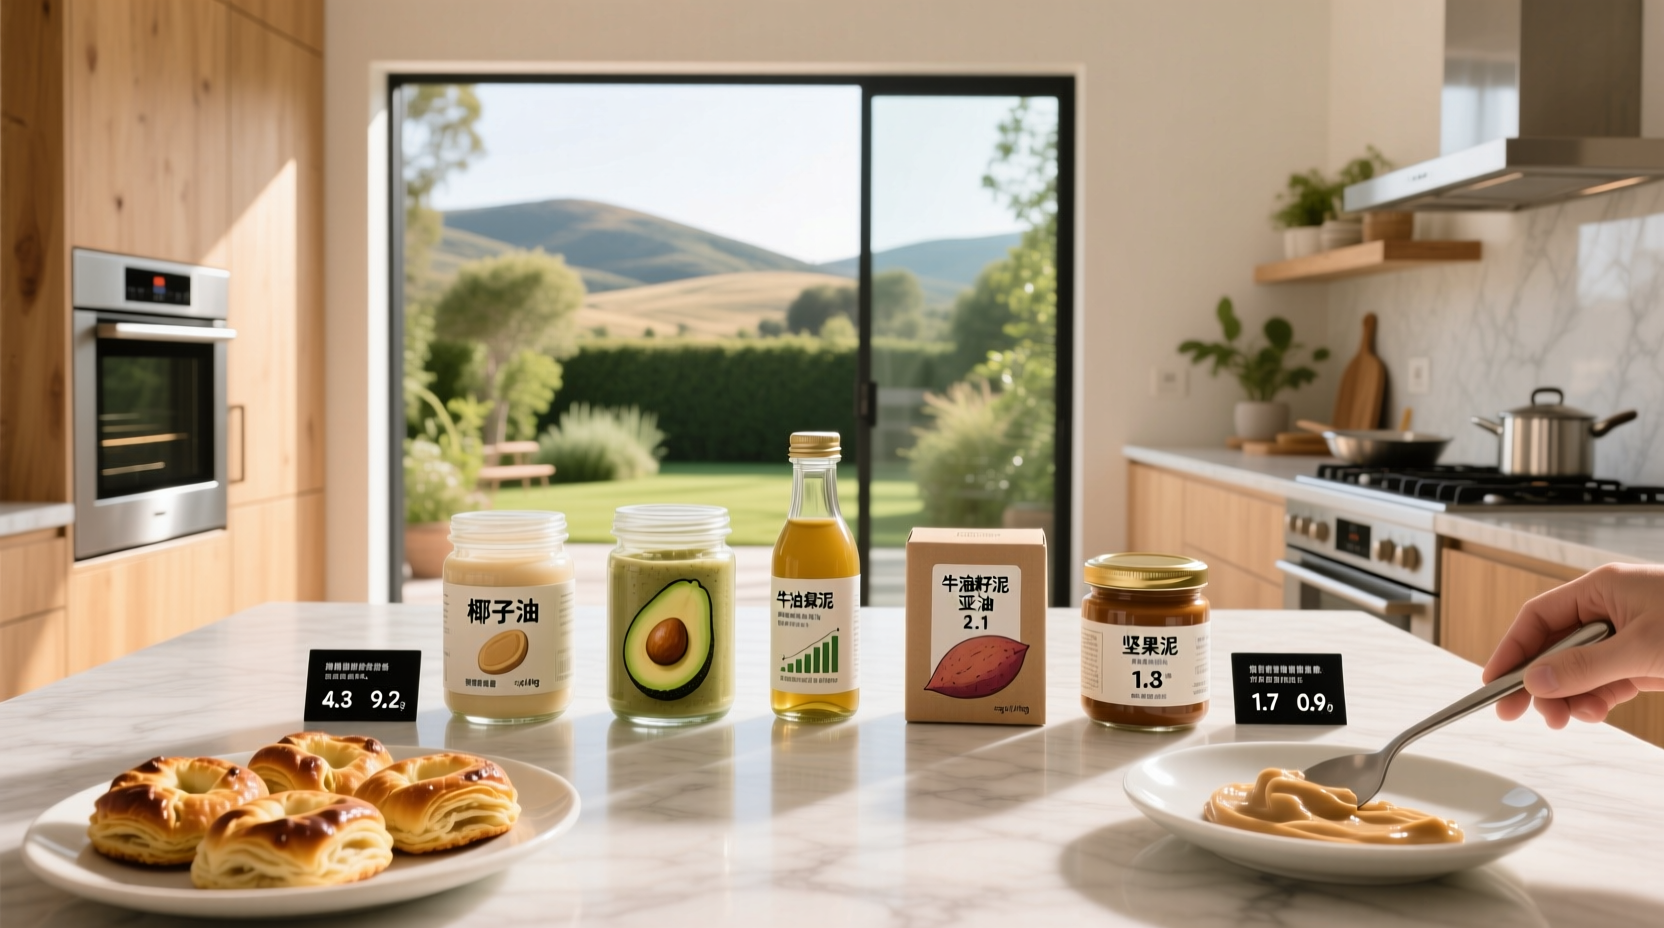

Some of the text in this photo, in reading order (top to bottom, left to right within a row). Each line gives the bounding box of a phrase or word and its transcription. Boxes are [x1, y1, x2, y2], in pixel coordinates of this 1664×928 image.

[467, 598, 539, 625] 椰子油
[963, 614, 988, 630] 2.1
[1122, 635, 1179, 656] 坚果泥
[1131, 670, 1163, 689] 1.8
[321, 690, 353, 709] 4.3
[1251, 692, 1279, 711] 1.7
